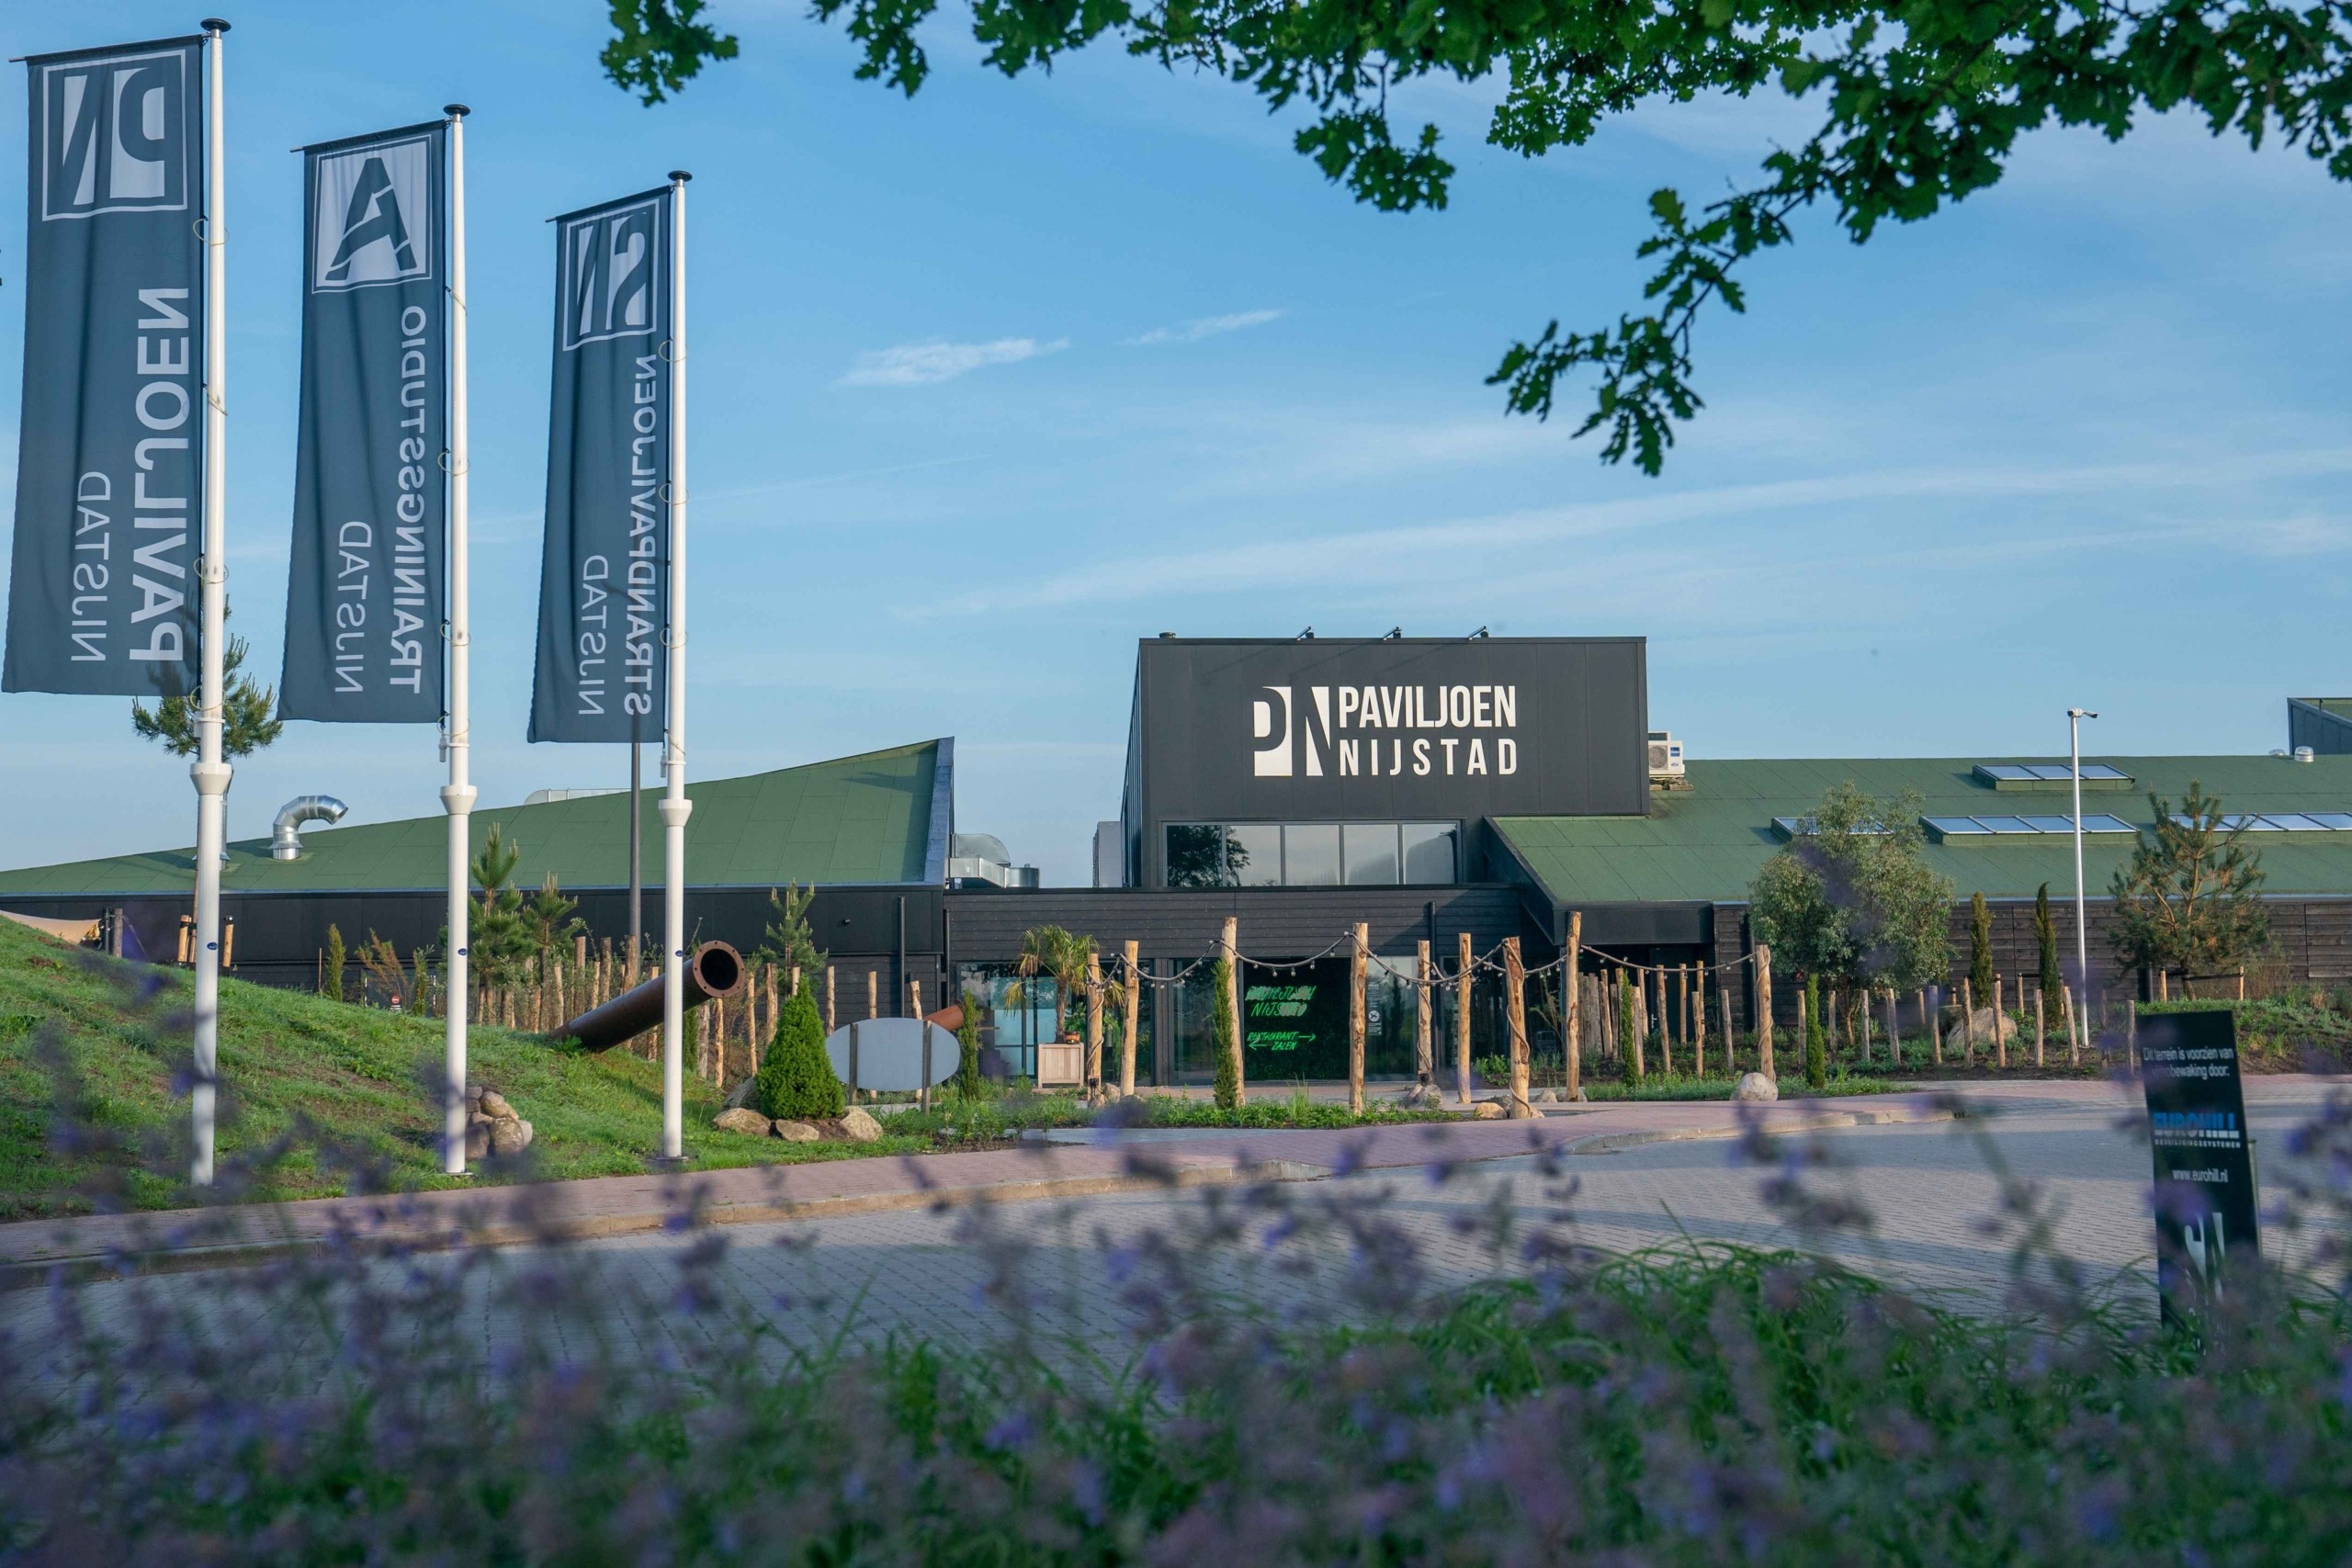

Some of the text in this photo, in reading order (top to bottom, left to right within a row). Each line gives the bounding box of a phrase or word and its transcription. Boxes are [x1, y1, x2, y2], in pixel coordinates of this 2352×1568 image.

[1339, 685, 1516, 728] PAVILJOEN
[1340, 739, 1517, 776] NIJSTAD
[1271, 1041, 1297, 1051] ZALEN
[2154, 1046, 2177, 1061] terrein
[2177, 1046, 2186, 1060] is
[2186, 1046, 2219, 1060] voorzien
[2219, 1047, 2234, 1059] van
[2151, 1064, 2208, 1080] viobewaking
[2172, 1168, 2229, 1183] www.eurohill.nl
